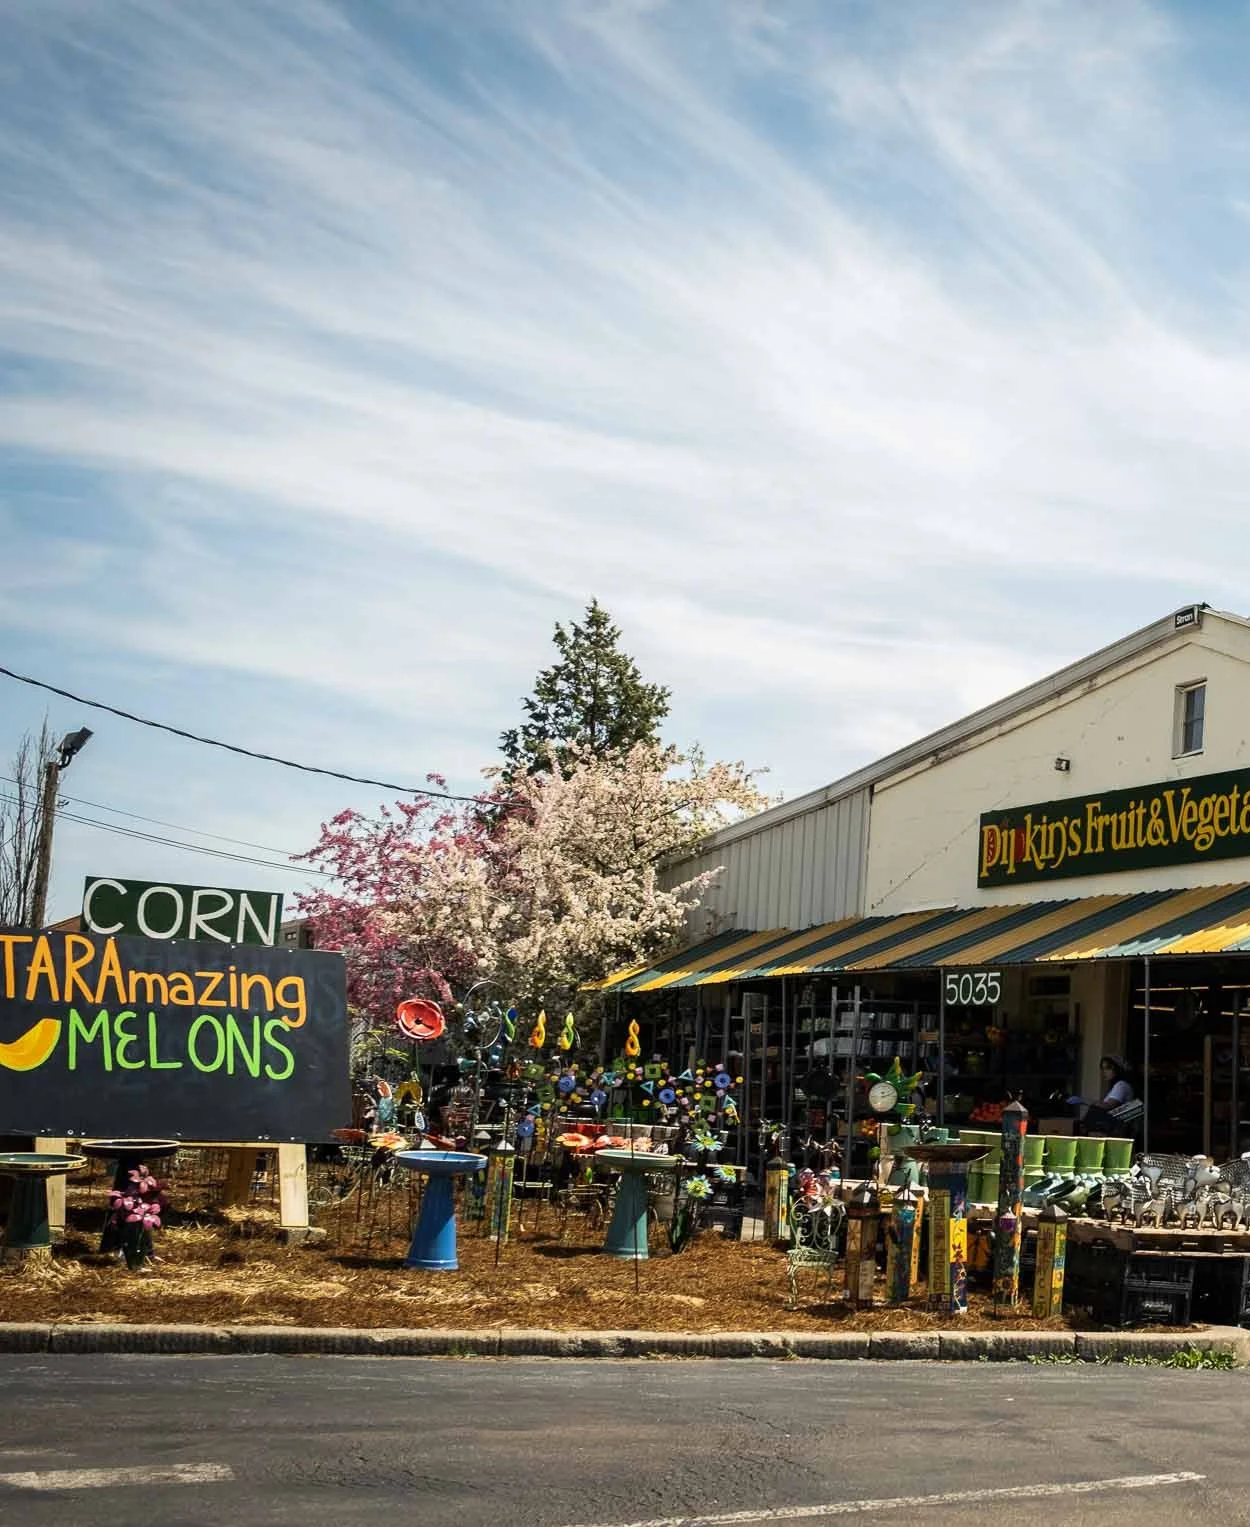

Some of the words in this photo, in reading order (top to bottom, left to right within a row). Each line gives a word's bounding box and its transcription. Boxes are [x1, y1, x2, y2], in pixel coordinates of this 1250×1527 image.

[83, 879, 278, 947] CORN
[946, 972, 1001, 1005] 5035
[68, 1008, 295, 1081] MELONS
